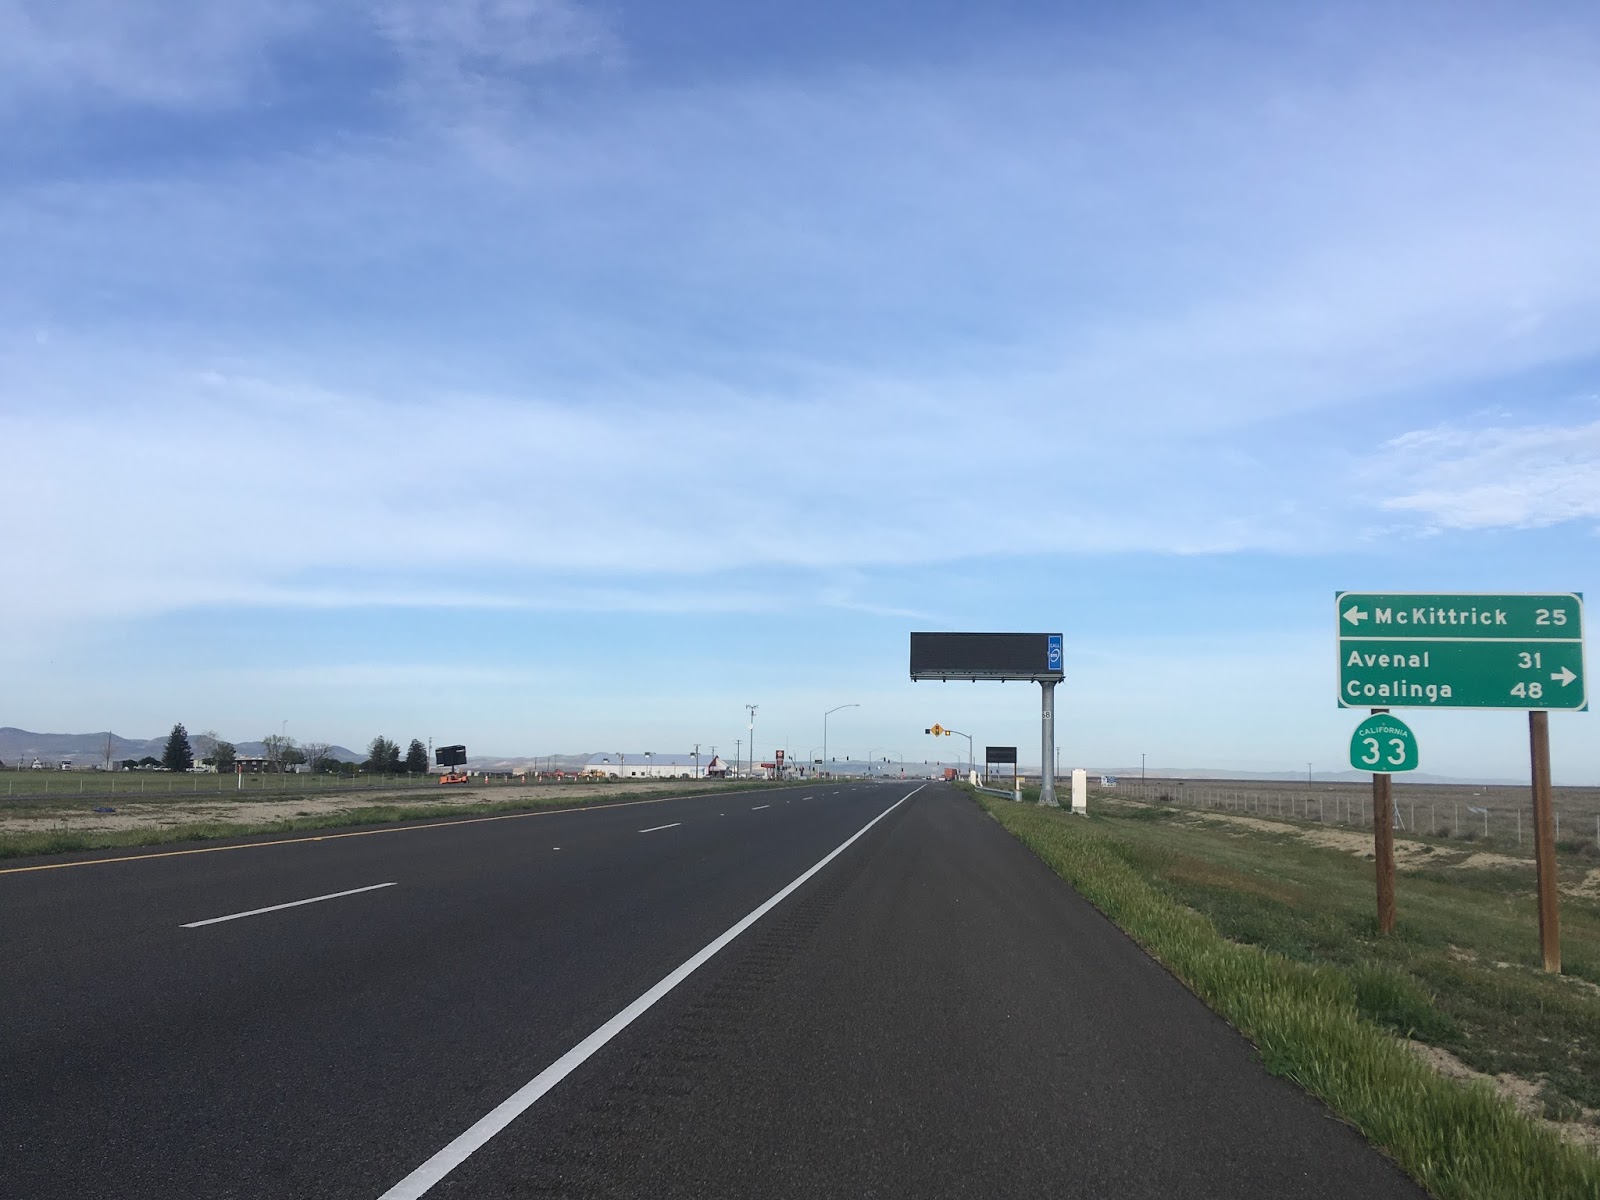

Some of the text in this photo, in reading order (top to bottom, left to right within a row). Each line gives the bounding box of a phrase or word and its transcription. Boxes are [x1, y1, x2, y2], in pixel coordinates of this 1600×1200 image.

[1375, 608, 1567, 626] McKittrick 25
[1347, 651, 1542, 669] Avenal 31
[1347, 680, 1543, 702] Coalinga 48
[1359, 726, 1408, 738] CALIFORNIA
[1361, 737, 1406, 765] 33
